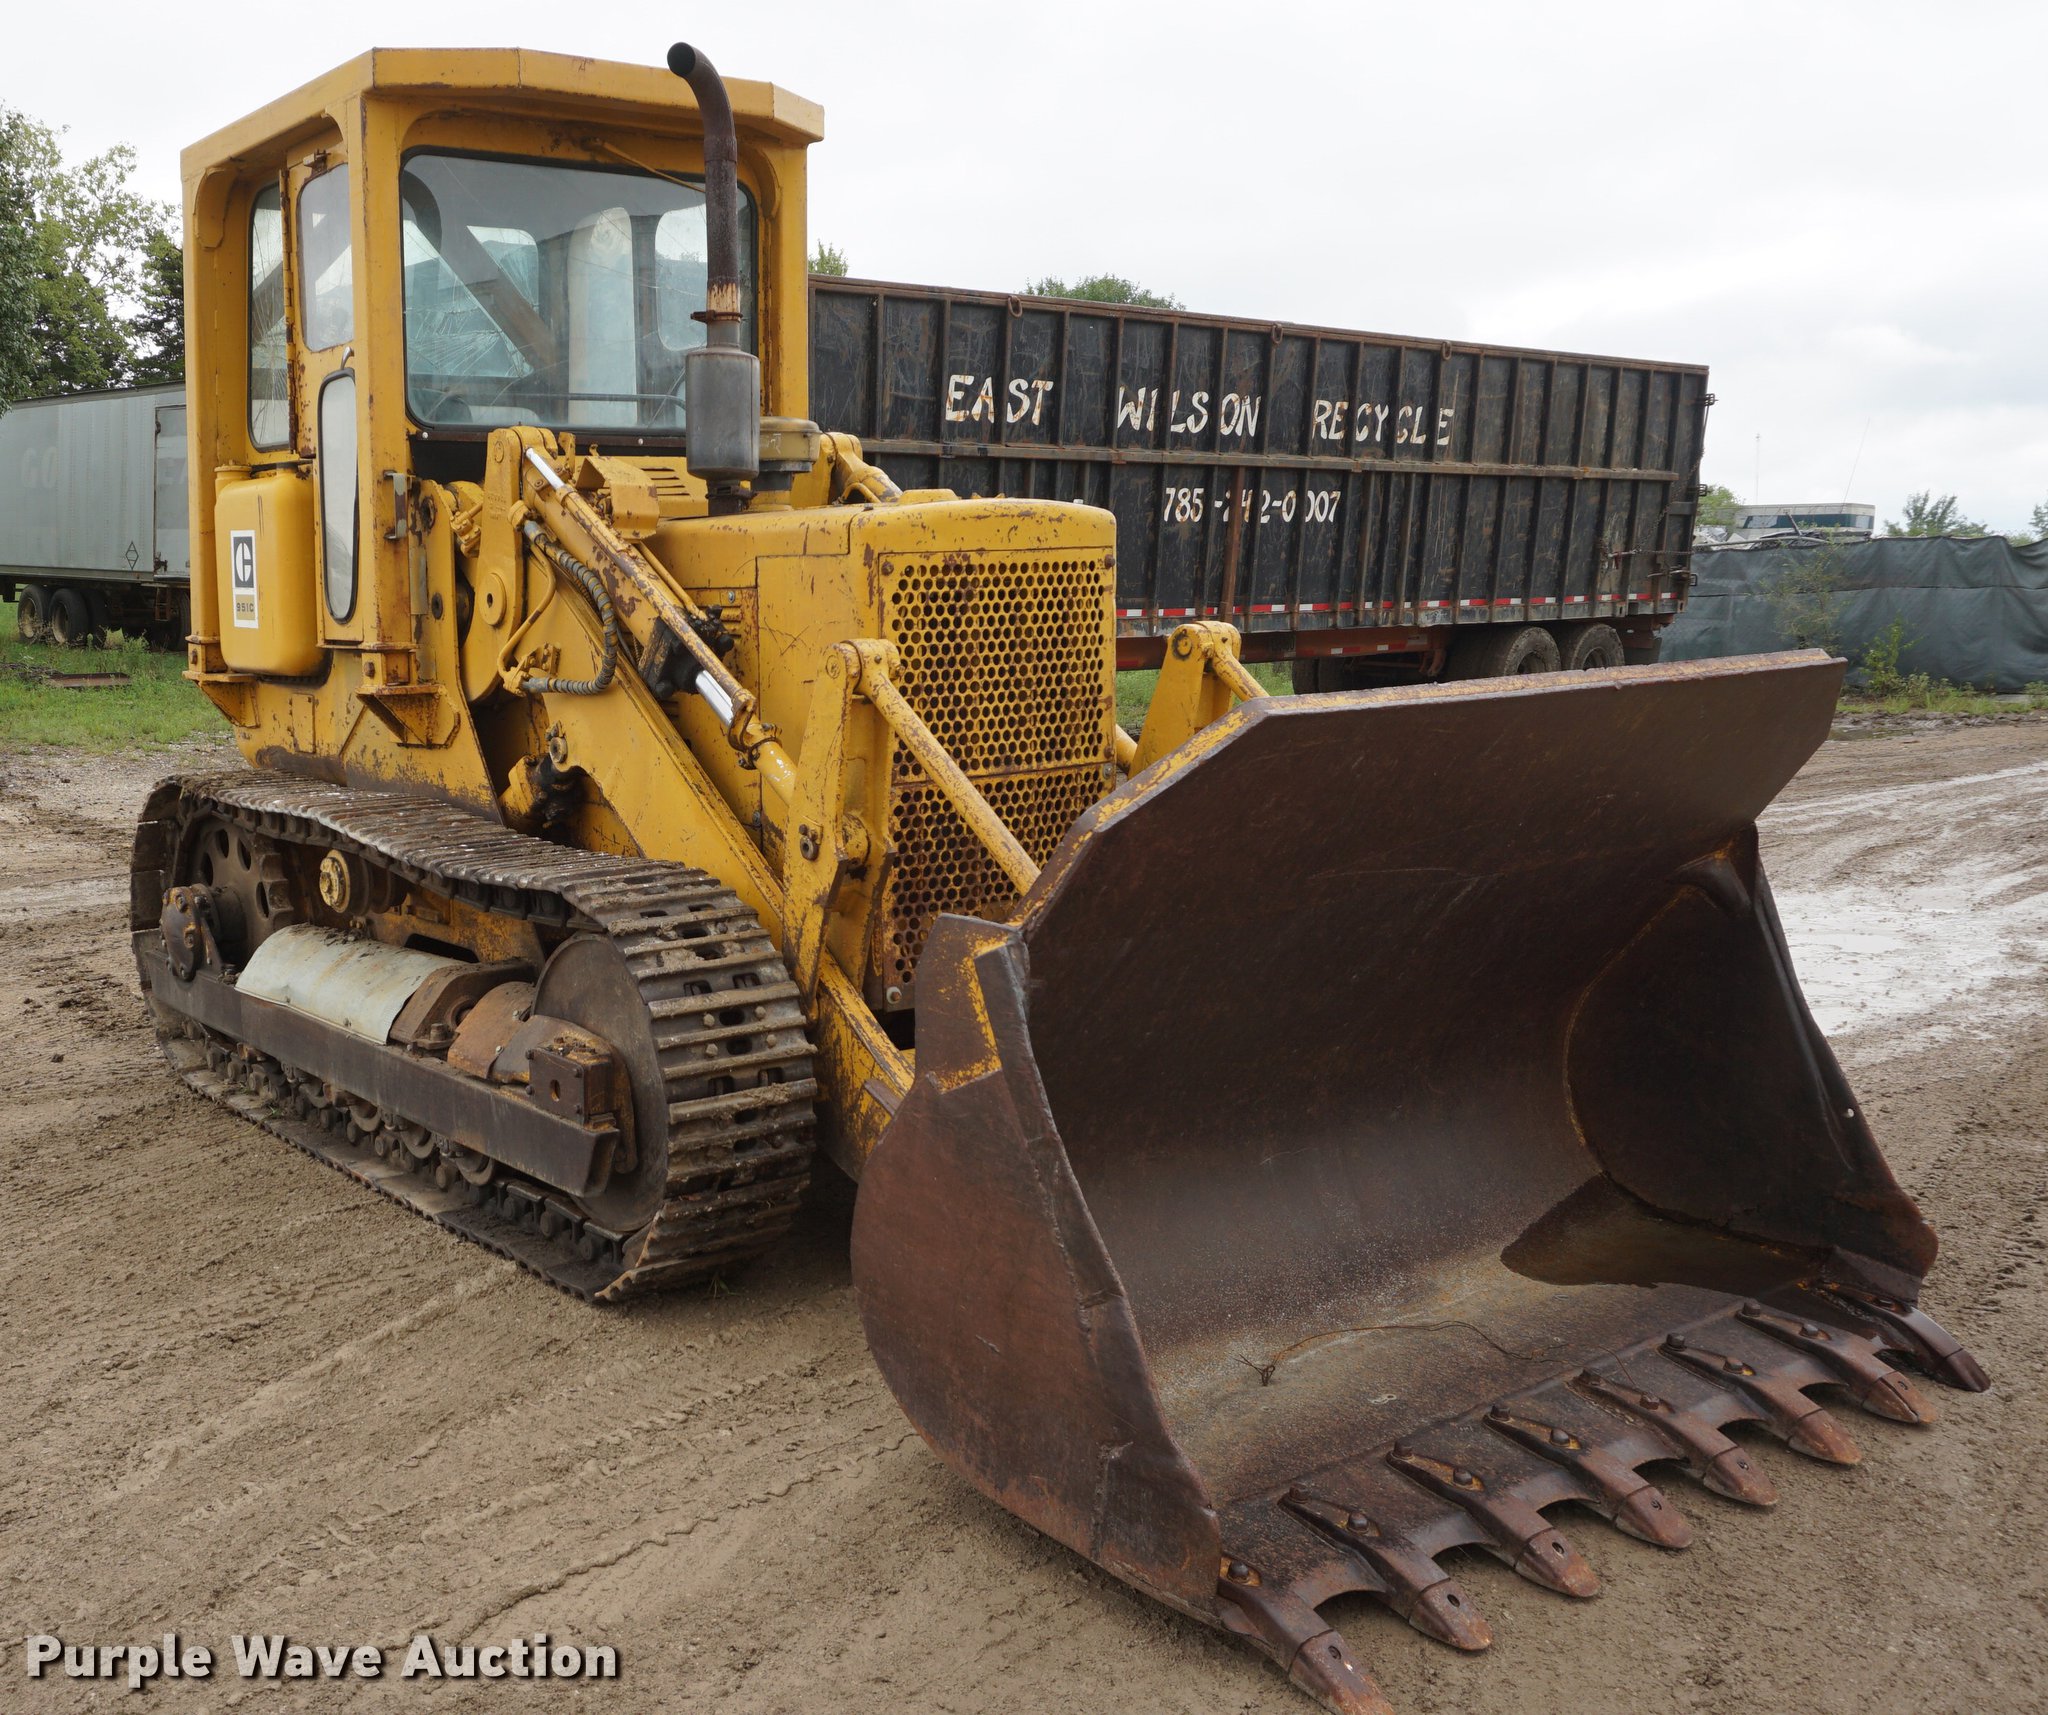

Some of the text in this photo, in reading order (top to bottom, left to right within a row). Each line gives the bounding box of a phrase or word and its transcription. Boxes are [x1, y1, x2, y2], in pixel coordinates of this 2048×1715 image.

[945, 374, 1455, 446] EAST WILSON RECYCLE
[236, 602, 255, 613] 951C
